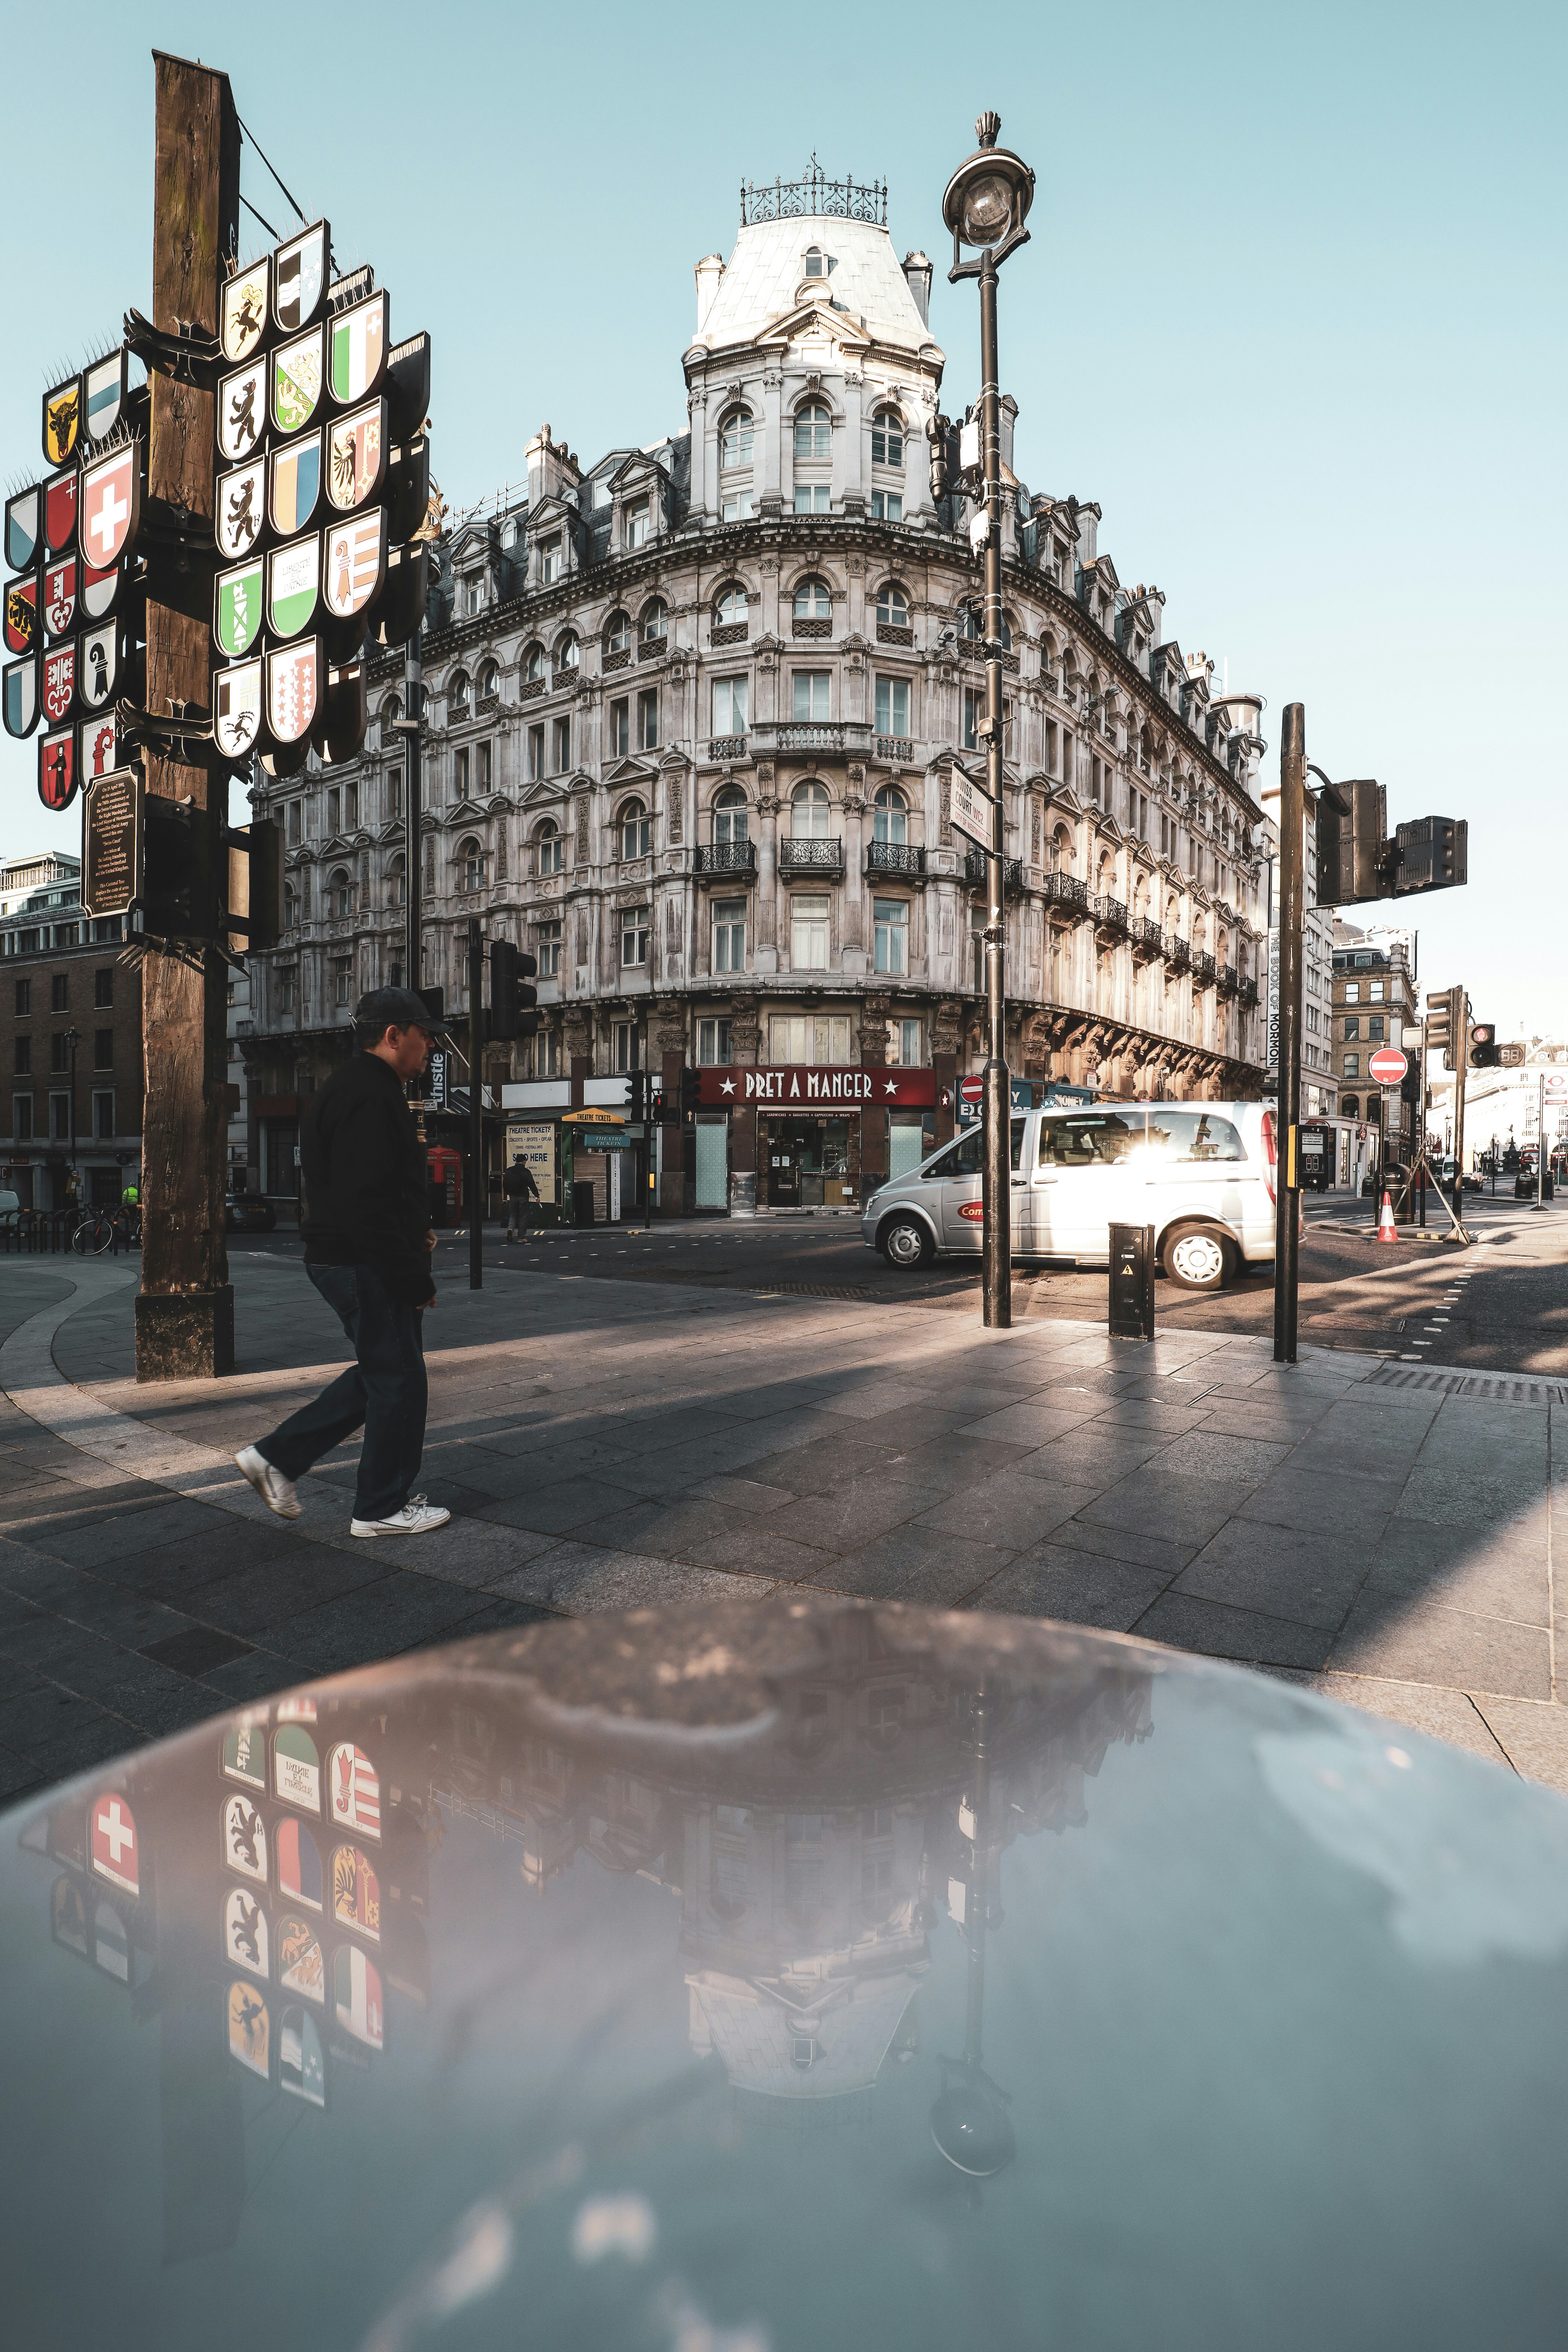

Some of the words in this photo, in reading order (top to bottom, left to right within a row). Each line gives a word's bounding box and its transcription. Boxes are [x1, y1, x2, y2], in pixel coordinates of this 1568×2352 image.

[254, 514, 261, 527] R
[227, 526, 234, 537] V
[282, 556, 311, 576] LIBERTÉ
[291, 569, 301, 581] ET
[283, 576, 308, 593] PATRIE
[91, 628, 111, 640] BASEL-STADT
[956, 775, 972, 799] SWISS
[956, 790, 972, 815] COURT
[974, 806, 984, 825] WC2
[963, 817, 967, 825] OF
[968, 821, 988, 844] WESTMINSTER
[1271, 957, 1280, 991] BOOK
[1270, 994, 1279, 1010] OF
[1269, 1014, 1279, 1066] MORMON
[430, 1053, 443, 1102] thistle
[746, 1072, 784, 1098] PRET
[790, 1072, 801, 1098] A
[807, 1072, 872, 1098] MANGER
[530, 1153, 547, 1162] HERE
[962, 1207, 983, 1216] Com
